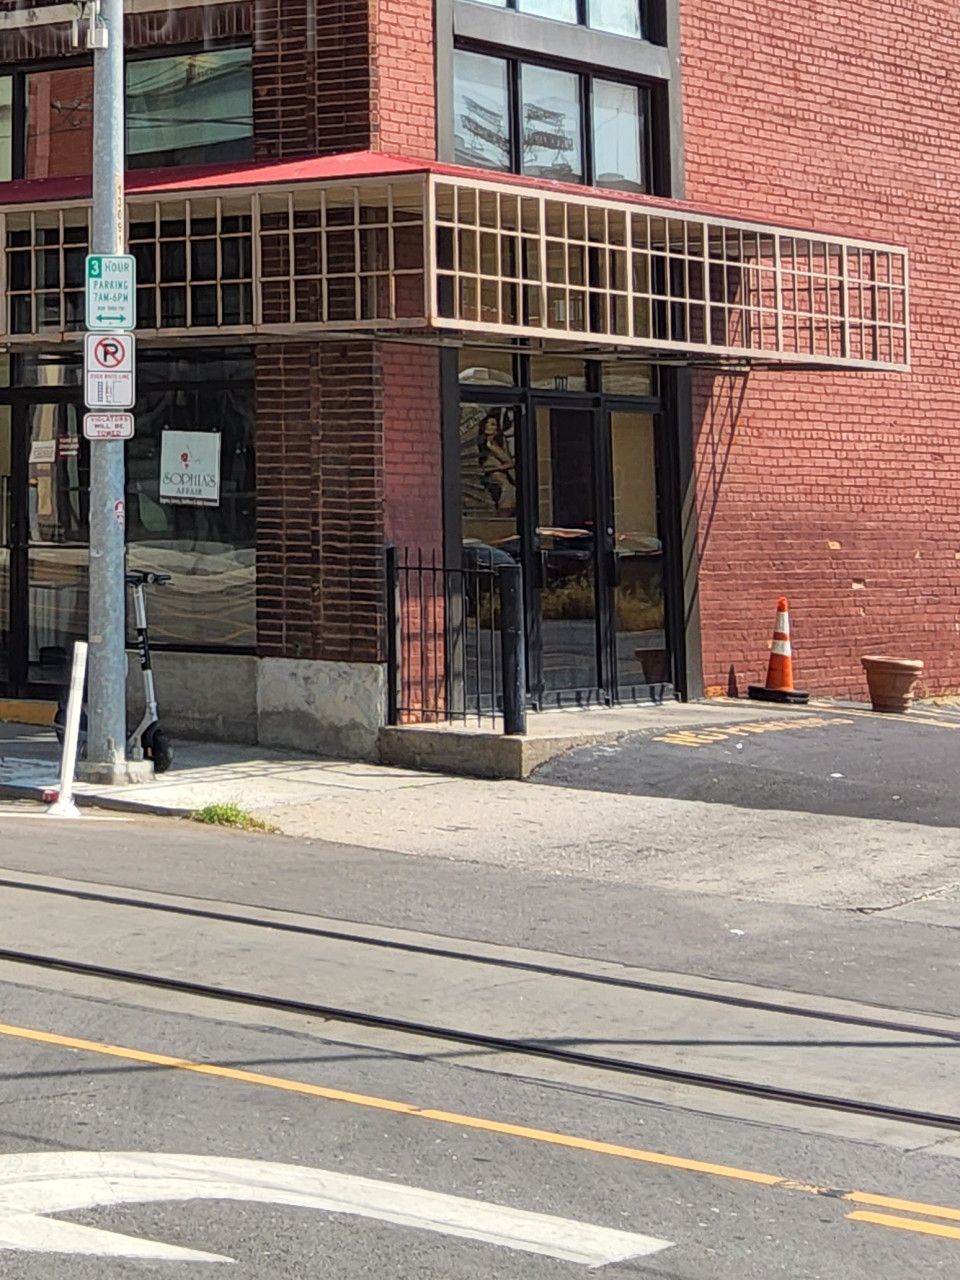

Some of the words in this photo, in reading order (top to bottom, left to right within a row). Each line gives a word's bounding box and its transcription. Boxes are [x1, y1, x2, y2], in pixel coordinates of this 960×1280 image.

[90, 260, 100, 276] 3
[104, 262, 130, 273] HOUR
[93, 280, 129, 290] PARKING
[93, 292, 129, 302] 7AM-6PM
[162, 472, 217, 488] SOPHIA'S
[175, 487, 203, 496] AFFAIR
